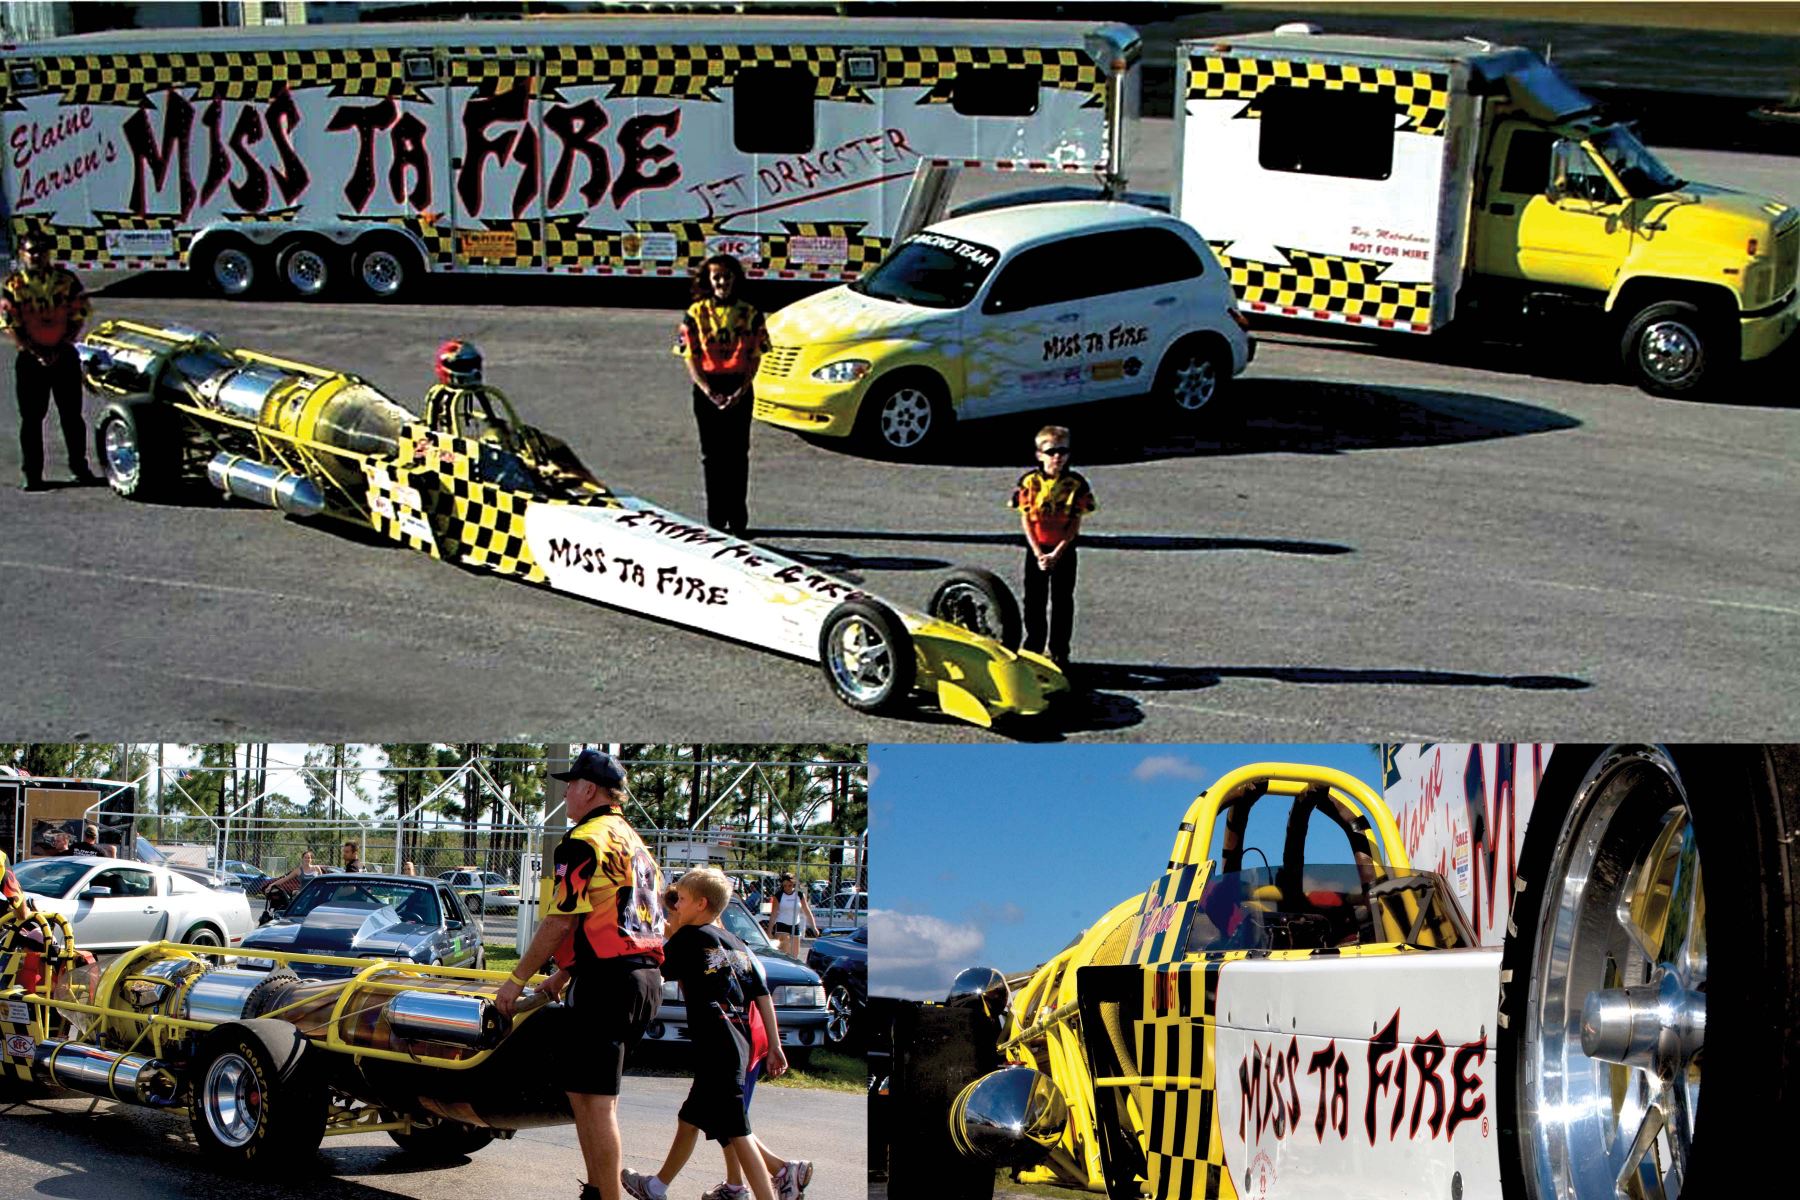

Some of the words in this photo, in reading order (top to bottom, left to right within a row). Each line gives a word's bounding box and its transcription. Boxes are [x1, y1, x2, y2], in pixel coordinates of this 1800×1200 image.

[10, 104, 93, 168] Elaine
[122, 86, 311, 224] MISS
[325, 95, 434, 214] TA
[457, 77, 681, 219] FIRE
[14, 136, 117, 209] Larsen's
[687, 173, 744, 220] JET
[759, 128, 915, 196] DRAGSTER
[954, 243, 995, 268] TEAM
[1349, 242, 1373, 254] NOT
[1376, 244, 1399, 257] FOR
[1402, 248, 1430, 261] HIRE
[1042, 332, 1081, 361] MISS
[1108, 324, 1148, 351] FIRE
[548, 537, 607, 574] MISS
[612, 556, 645, 588] TA
[656, 565, 729, 605] FIRE
[240, 1042, 269, 1139] GOODYEAR
[1238, 1035, 1300, 1147] MISS
[1307, 1037, 1350, 1145] TA
[1364, 1005, 1488, 1148] FIRE
